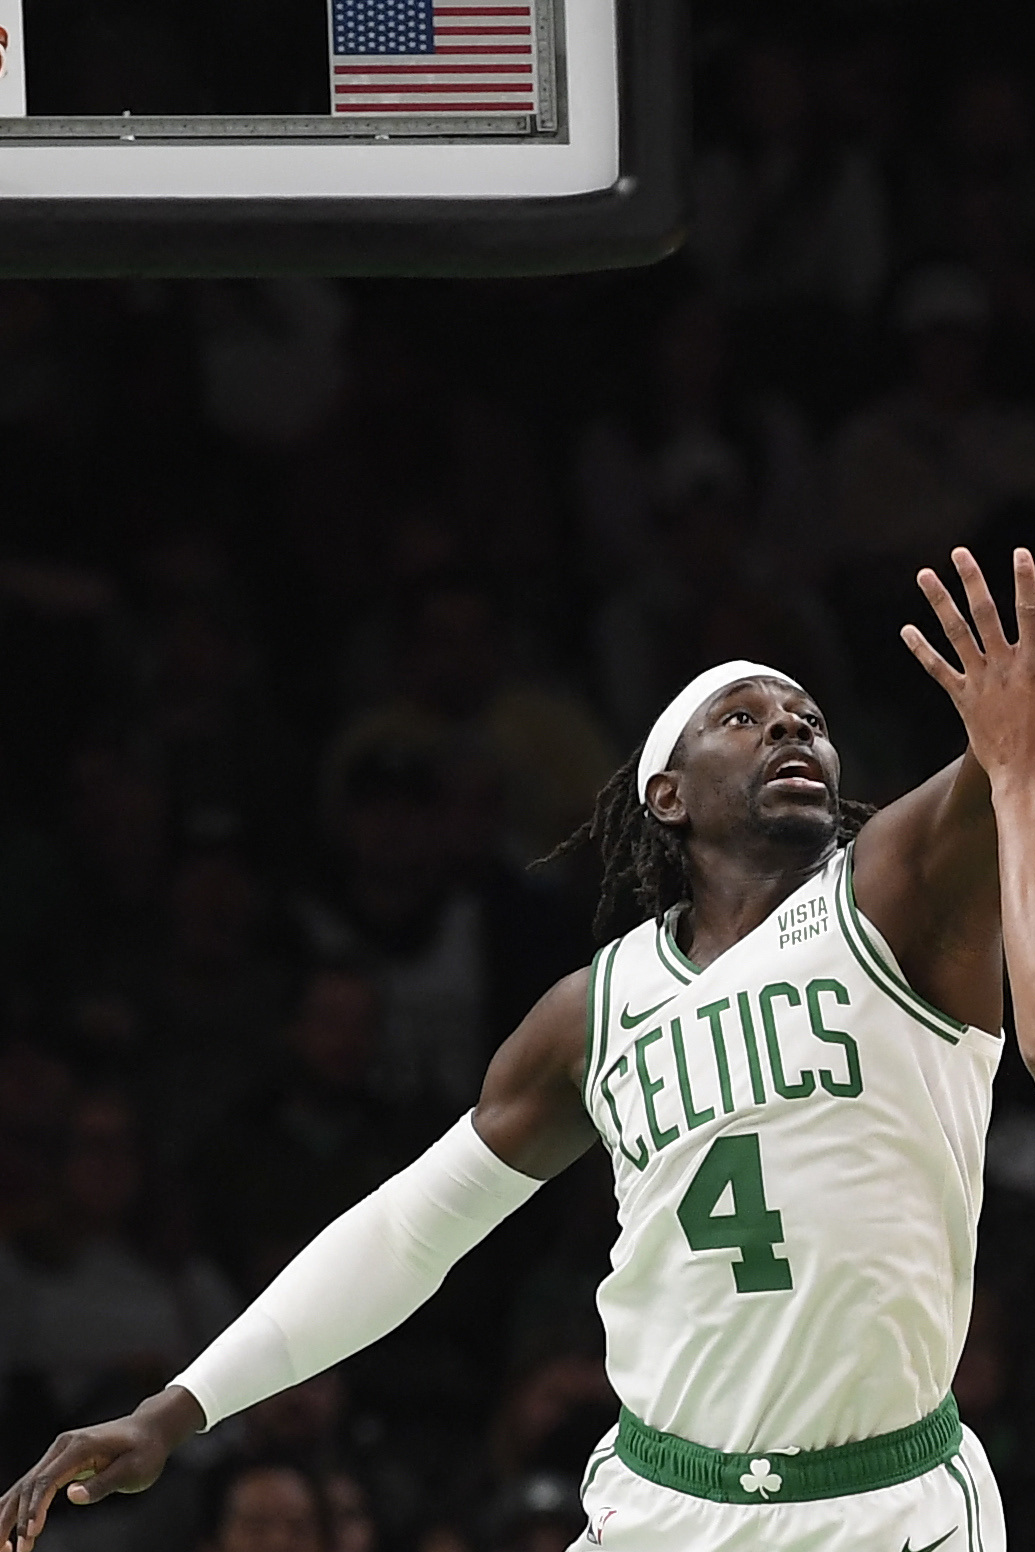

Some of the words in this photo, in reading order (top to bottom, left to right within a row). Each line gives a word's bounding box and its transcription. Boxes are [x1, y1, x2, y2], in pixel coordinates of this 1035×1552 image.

[777, 895, 828, 932] VISTA
[779, 915, 829, 949] PRINT
[600, 977, 863, 1172] CELTICS
[676, 1132, 793, 1294] 4
